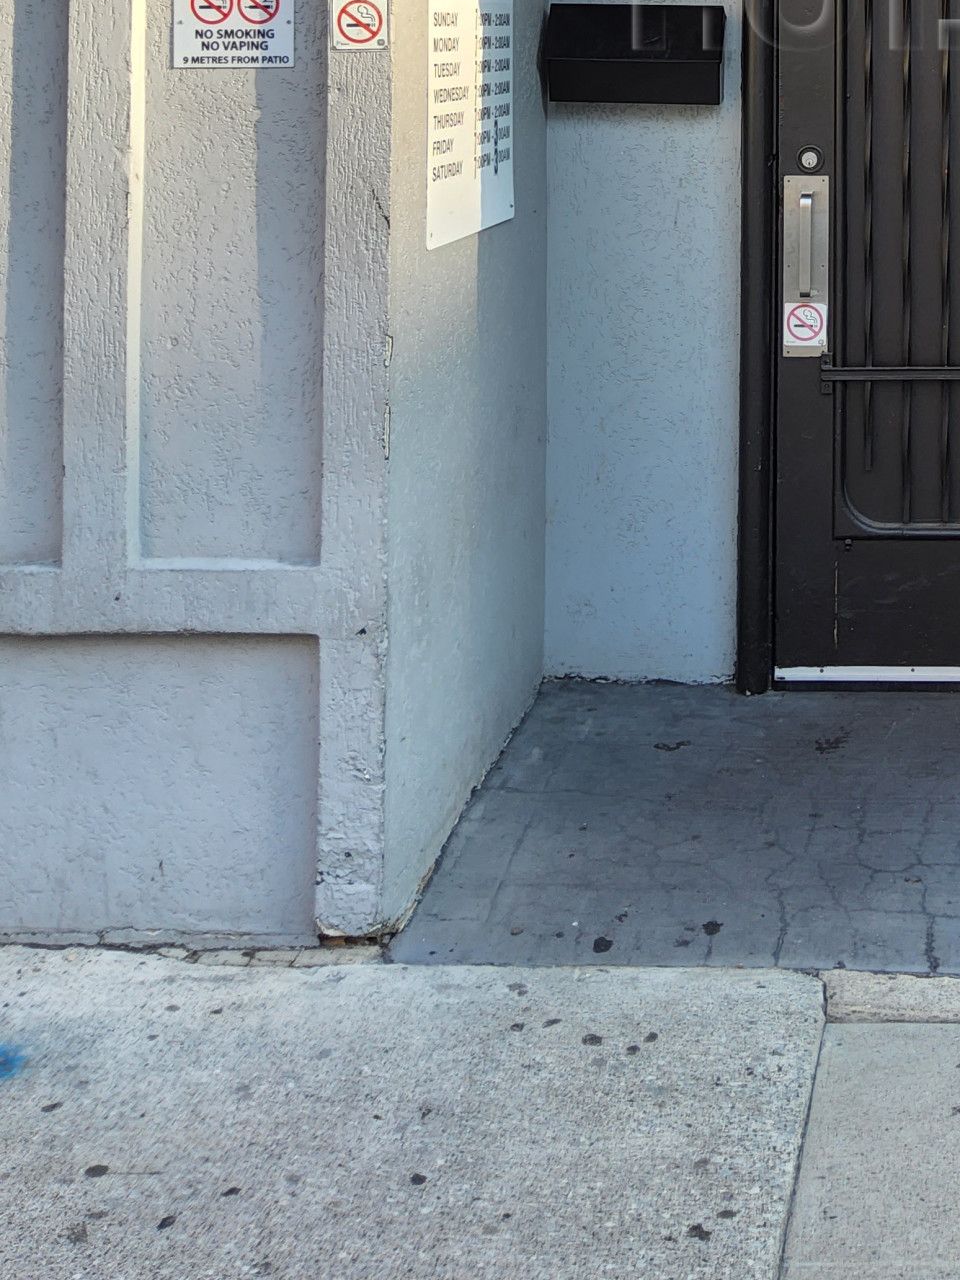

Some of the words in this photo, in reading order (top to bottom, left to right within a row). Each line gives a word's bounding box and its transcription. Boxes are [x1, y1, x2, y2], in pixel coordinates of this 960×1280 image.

[433, 12, 458, 27] SUNDAY
[195, 29, 213, 40] NO
[216, 29, 275, 40] SMOKING
[201, 41, 219, 51] NO
[222, 41, 269, 51] VAPING
[433, 37, 459, 52] MONDAY
[183, 56, 189, 64] 9
[191, 56, 229, 64] METRES
[231, 56, 259, 64] FROM
[262, 56, 290, 64] PATIO
[433, 62, 461, 78] TUESDAY
[433, 86, 469, 104] WEDNESDAY
[433, 111, 464, 130] THURSDAY
[433, 138, 454, 156] FRIDAY
[432, 160, 463, 182] SATURDAY
